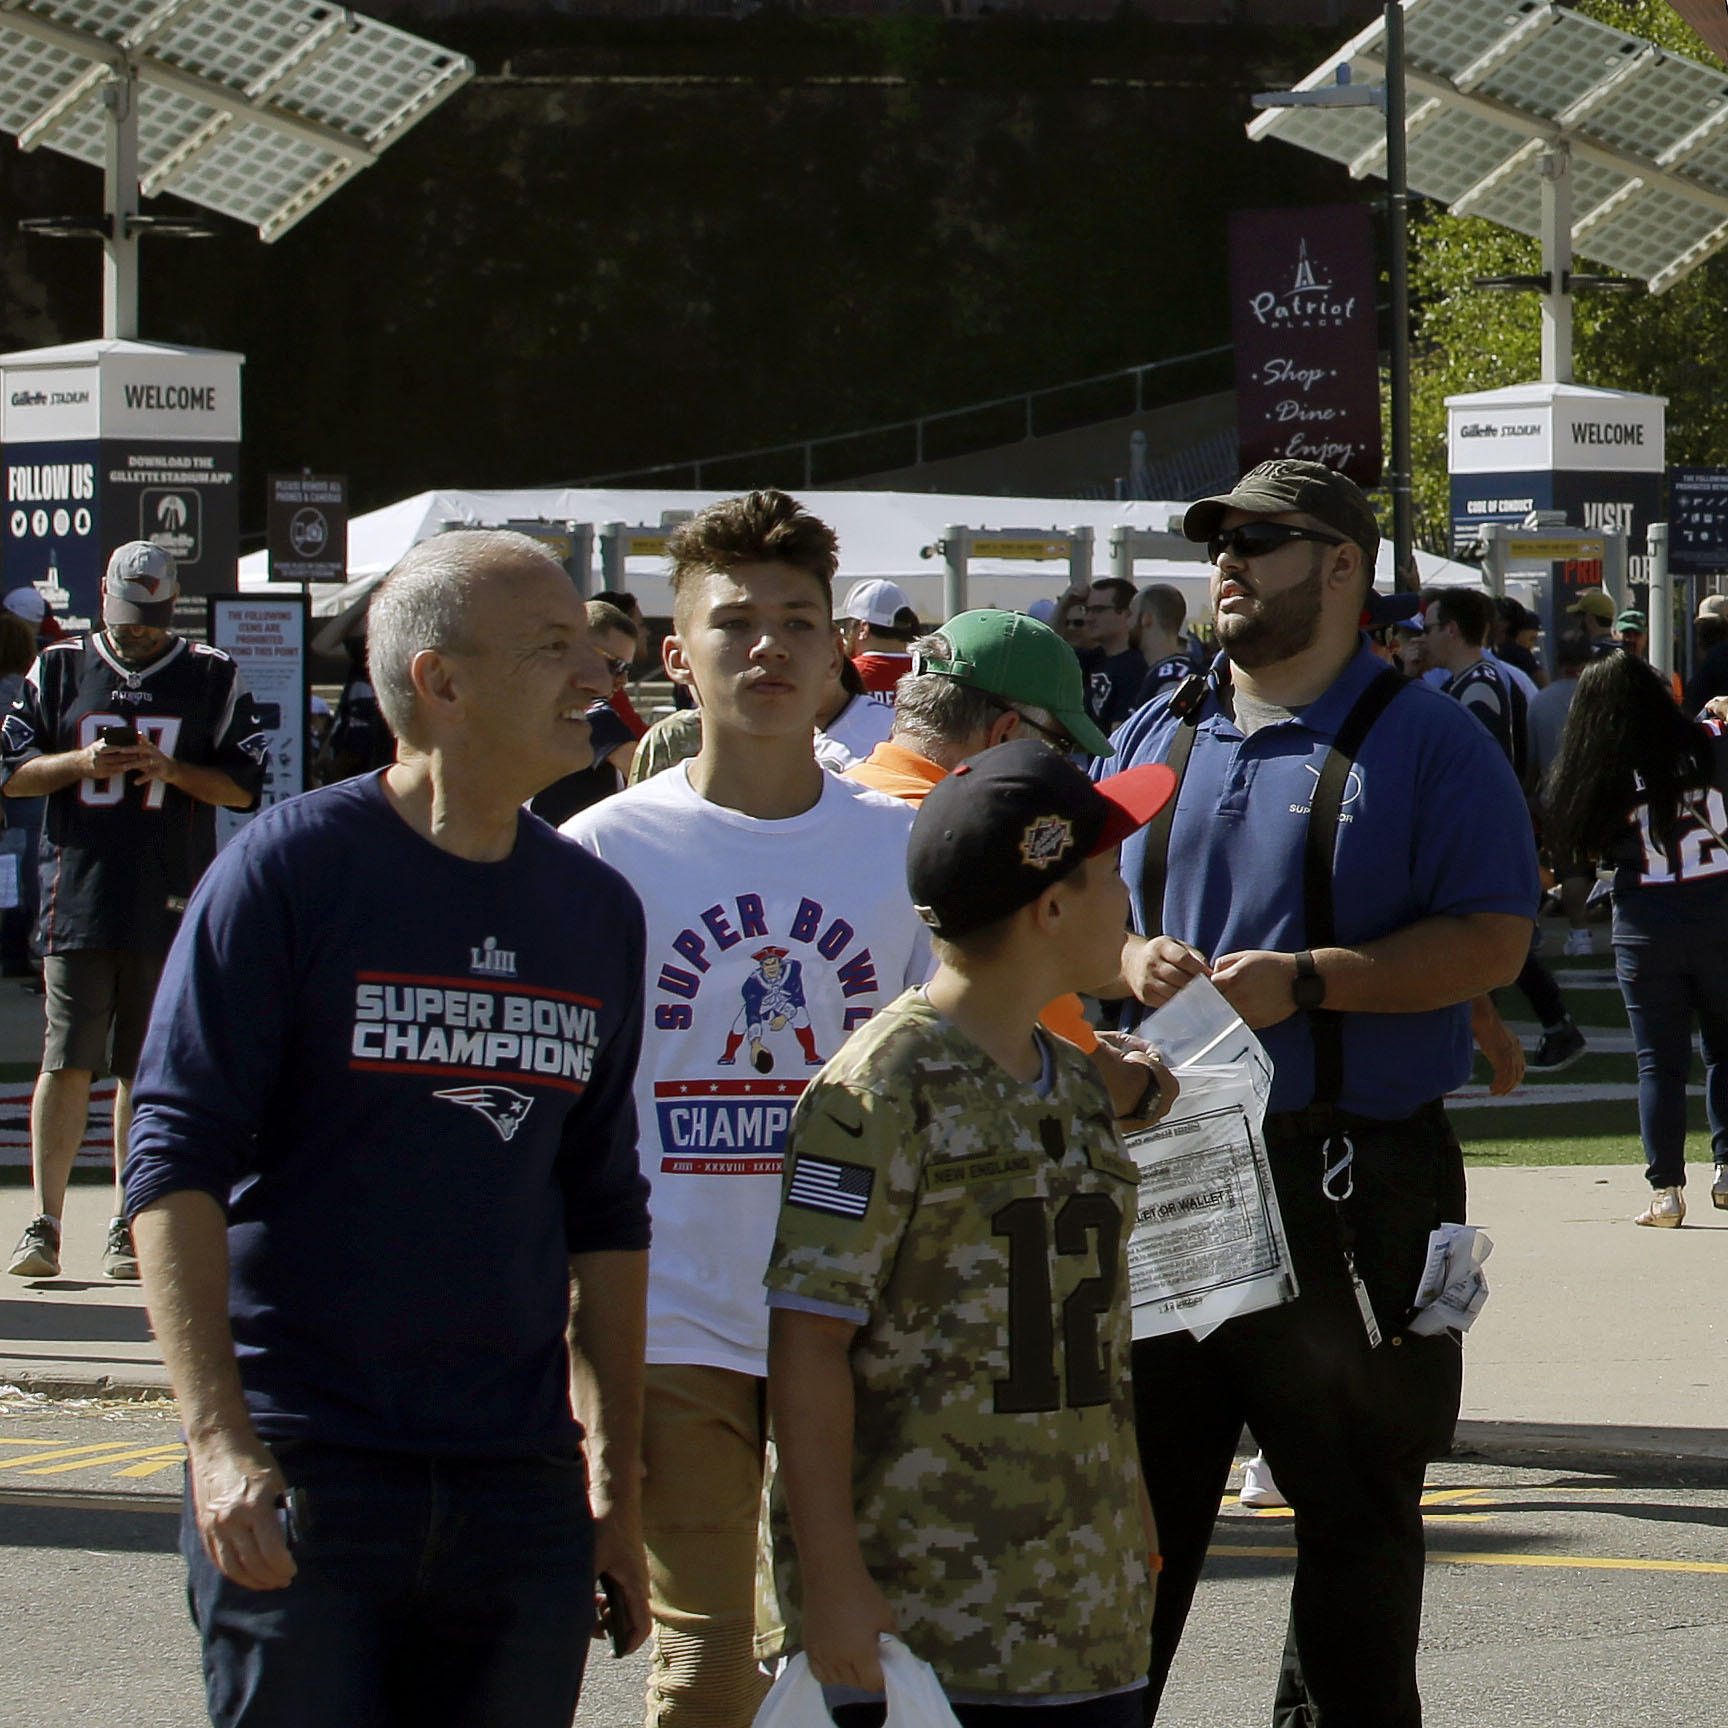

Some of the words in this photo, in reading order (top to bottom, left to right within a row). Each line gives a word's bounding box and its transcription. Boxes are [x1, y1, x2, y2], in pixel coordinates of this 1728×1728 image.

[1250, 291, 1355, 323] Patriot
[1263, 358, 1325, 391] Shop
[125, 384, 216, 411] WELCOME
[1276, 399, 1336, 422] Dine
[1460, 423, 1498, 438] Gillette
[1500, 423, 1541, 437] STADIUM
[1572, 423, 1645, 446] WELCOME
[1285, 432, 1356, 470] Enjoy
[8, 465, 70, 501] FOLLOW
[72, 463, 95, 500] US
[1583, 501, 1635, 536] VISIT
[655, 893, 769, 1030] SUPER
[789, 896, 879, 1032] BOWL
[356, 983, 495, 1029] SUPER
[504, 996, 600, 1048] BOWL
[352, 1021, 595, 1083] CHAMPIONS
[992, 1192, 1123, 1414] 12
